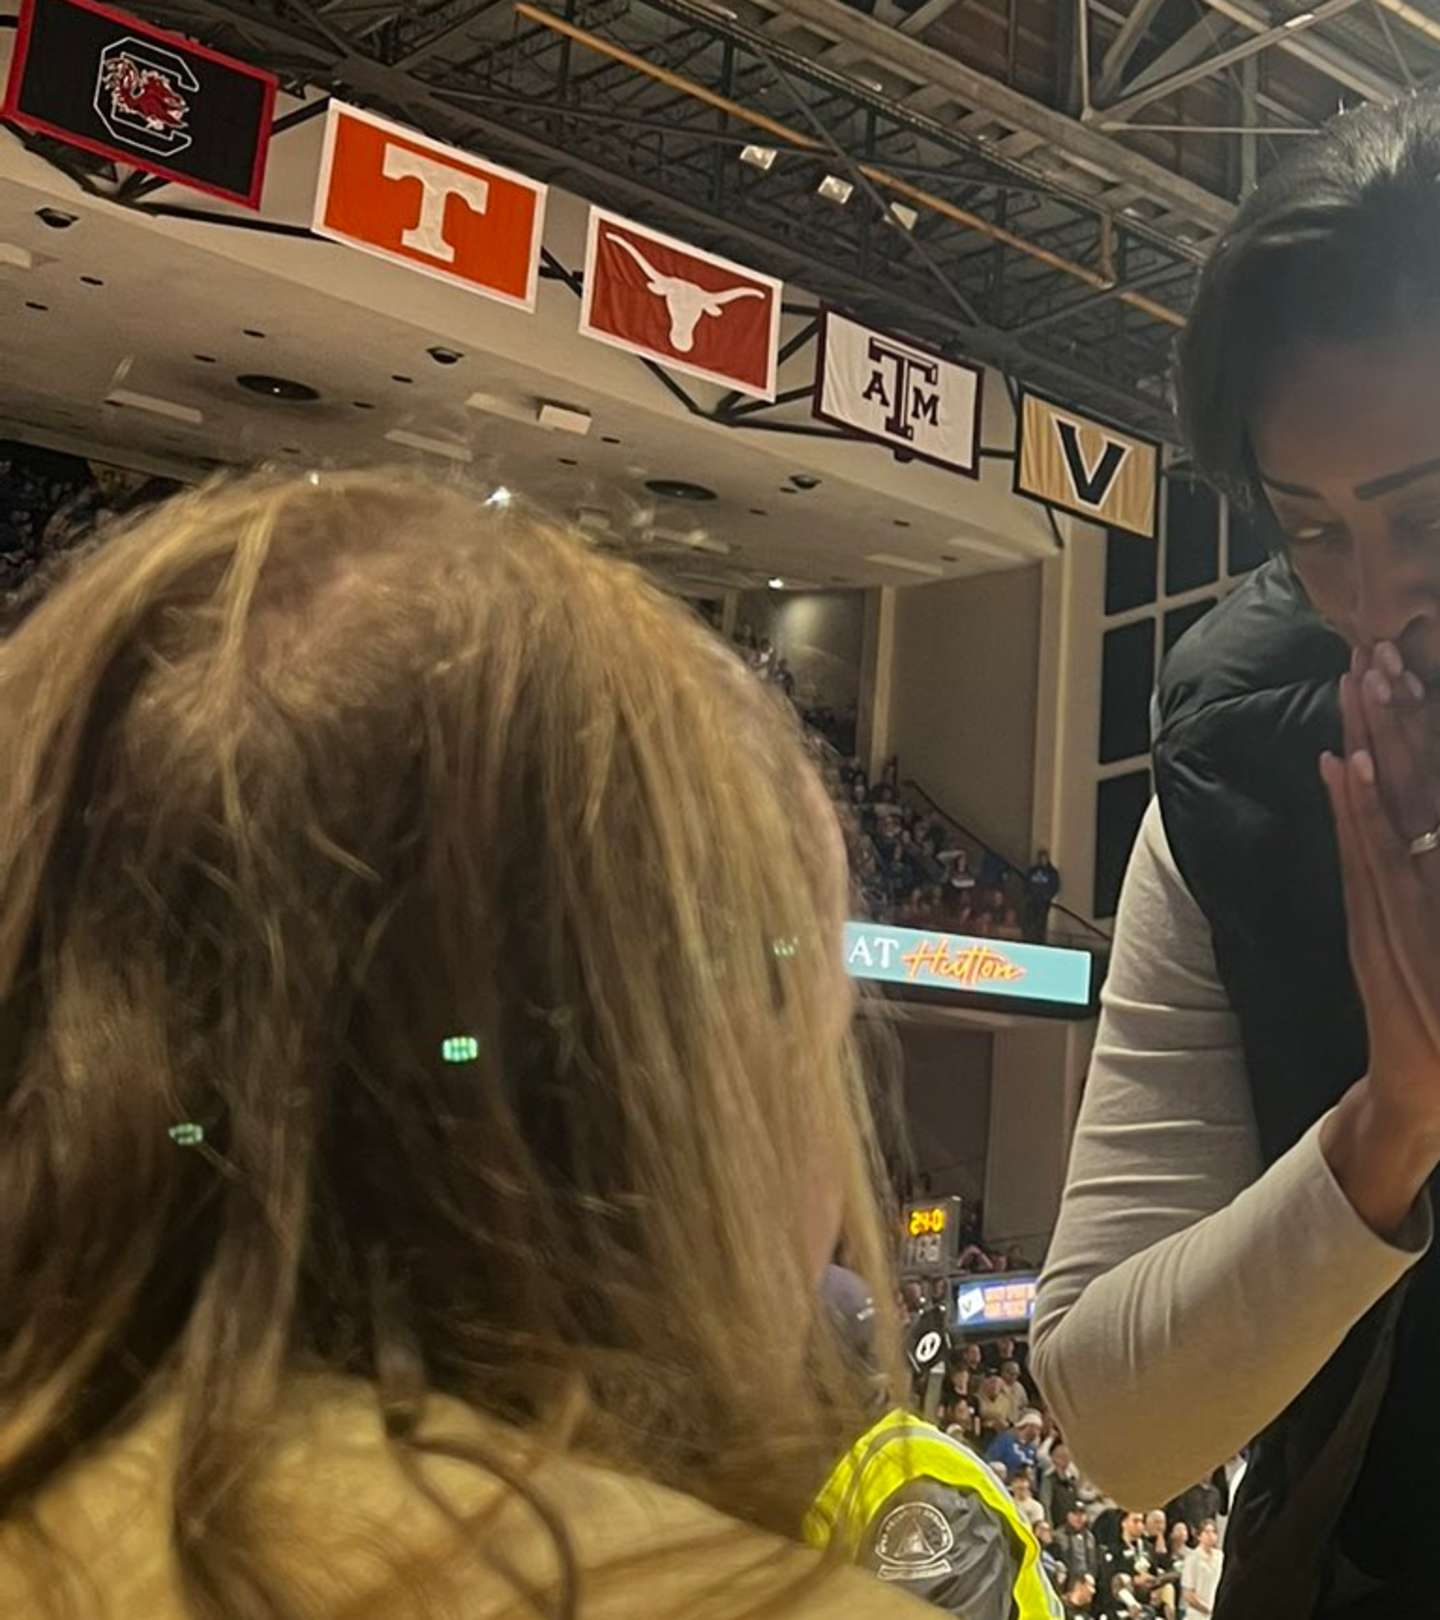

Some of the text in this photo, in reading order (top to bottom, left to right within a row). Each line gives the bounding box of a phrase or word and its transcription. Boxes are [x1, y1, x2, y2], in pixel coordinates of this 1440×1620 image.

[382, 143, 489, 263] T
[1051, 416, 1133, 508] V
[848, 935, 899, 968] AT
